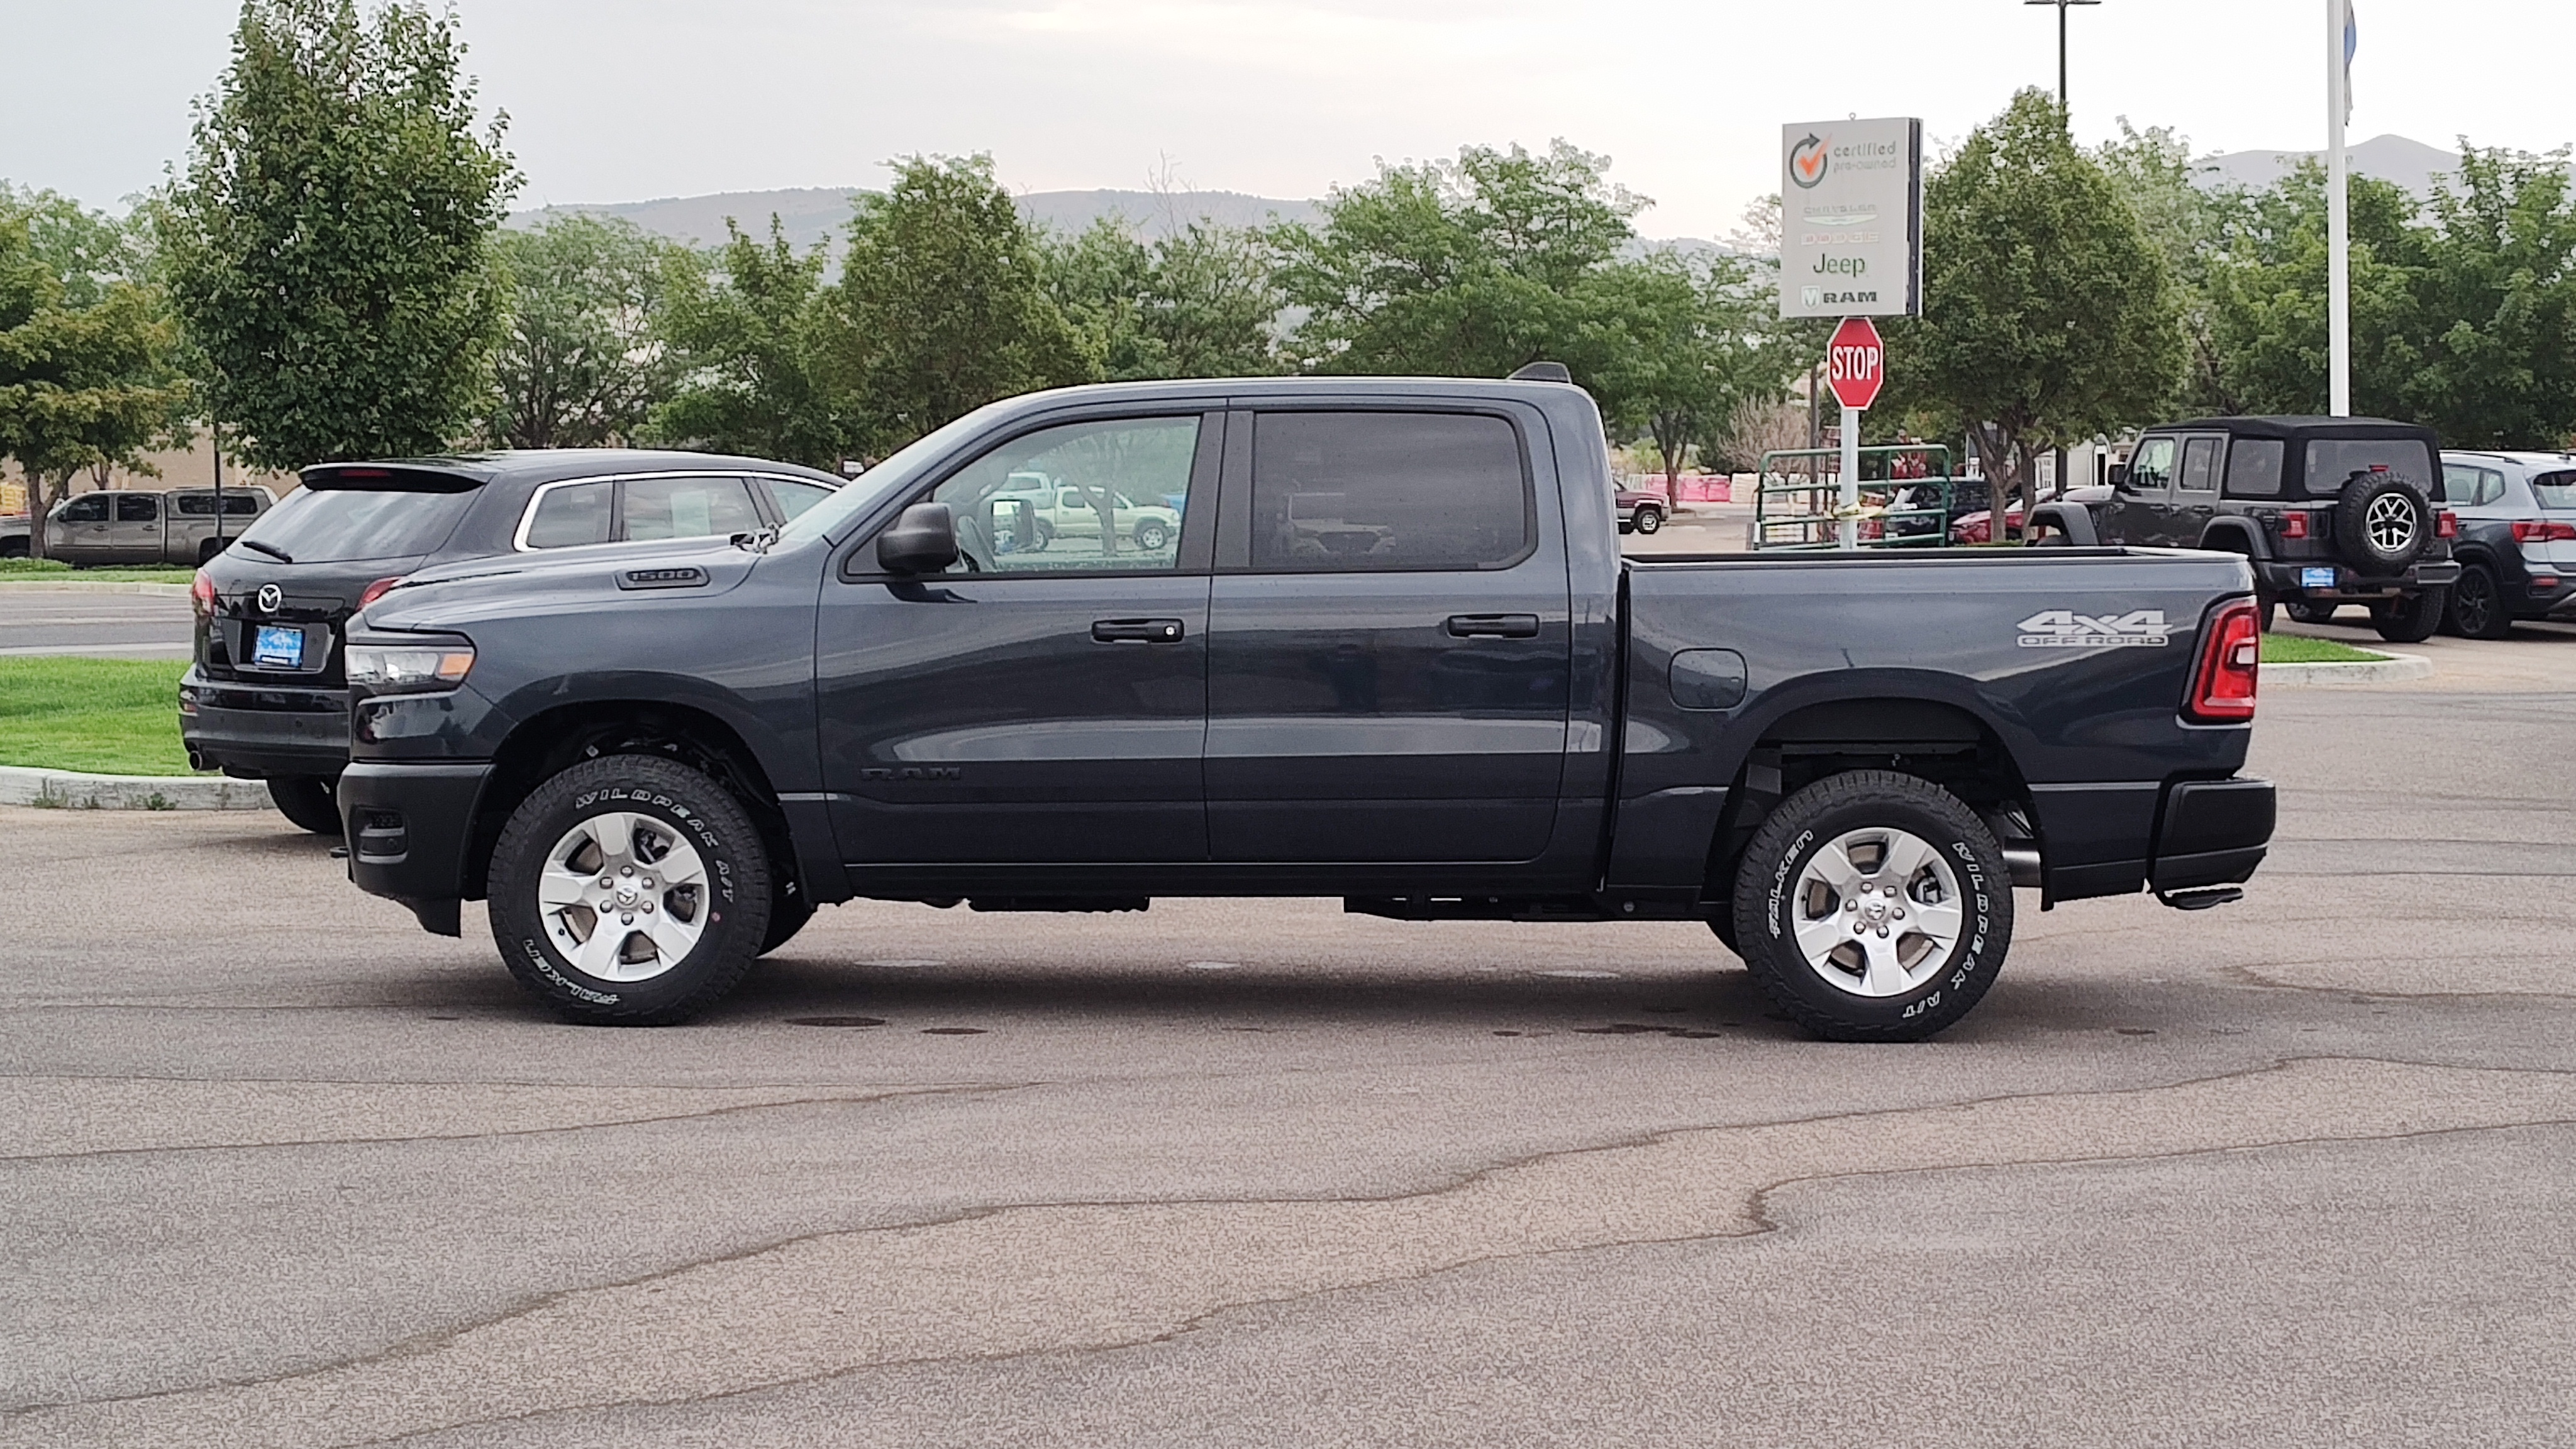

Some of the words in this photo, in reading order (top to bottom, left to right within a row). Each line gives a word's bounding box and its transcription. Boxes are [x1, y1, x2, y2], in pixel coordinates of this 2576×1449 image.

[1834, 140, 1896, 157] certified
[1801, 231, 1879, 245] DODGE
[1813, 253, 1865, 277] Jeep
[1824, 292, 1877, 303] RAM
[1831, 346, 1879, 380] STOP
[631, 570, 694, 581] 1500
[2022, 636, 2079, 645] OFF
[2086, 636, 2165, 645] ROAD
[861, 767, 960, 781] RAM
[575, 787, 719, 848] WILDPEAK
[1951, 841, 1990, 991] WILDPEAK
